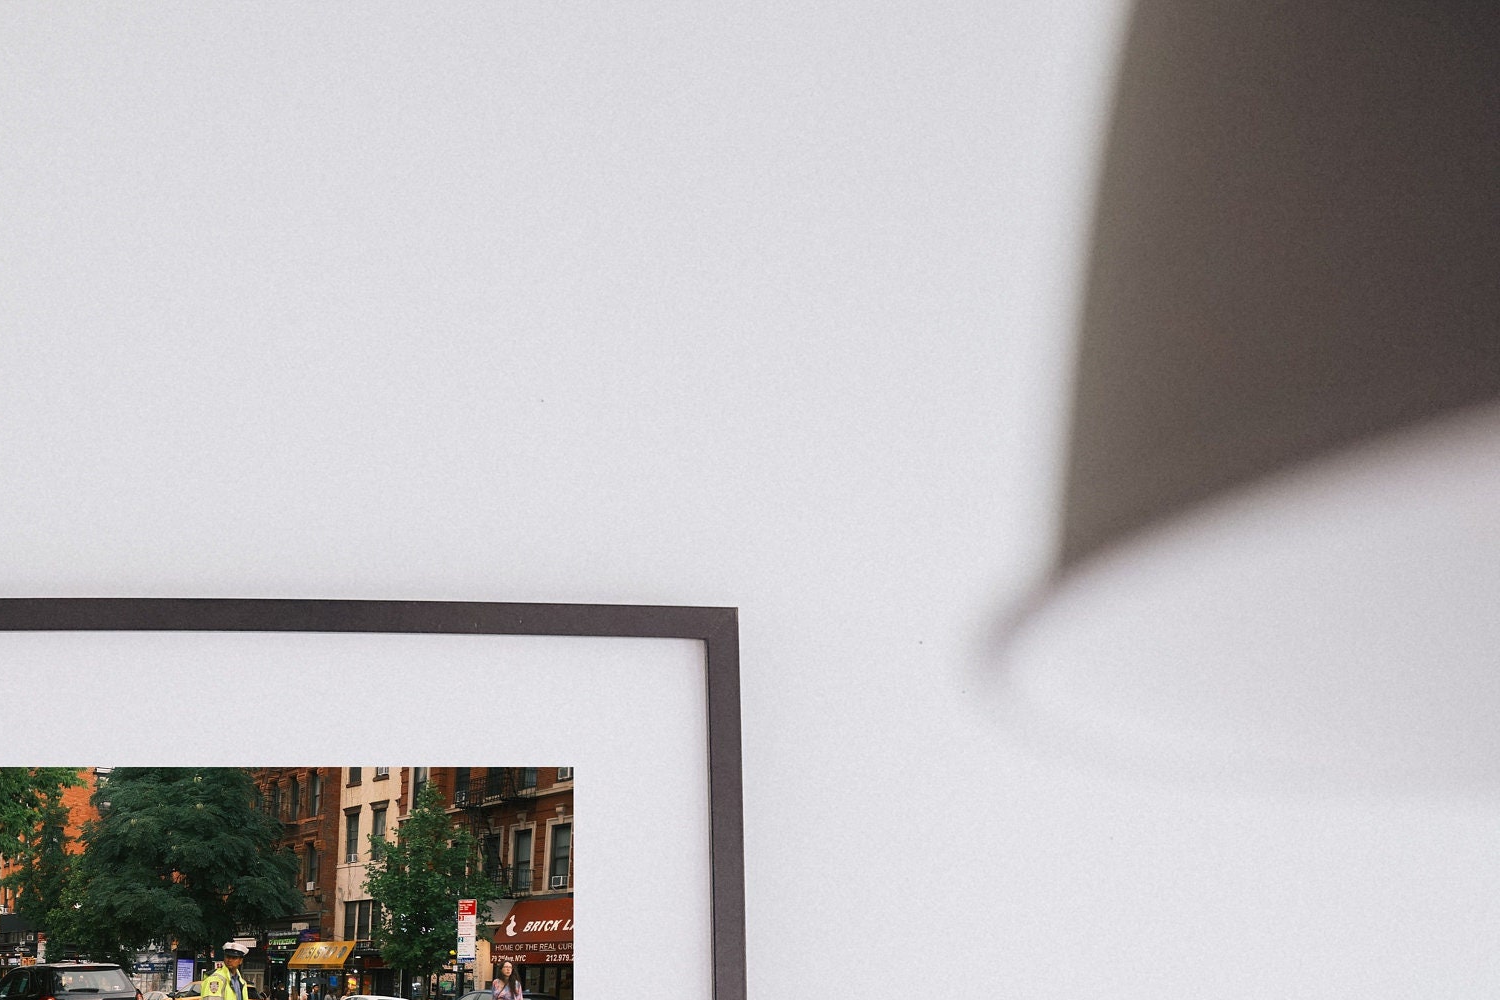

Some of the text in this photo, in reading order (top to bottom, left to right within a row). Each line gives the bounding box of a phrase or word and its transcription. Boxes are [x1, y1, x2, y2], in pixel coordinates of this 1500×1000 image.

[523, 919, 563, 932] BRICK
[525, 943, 538, 951] THE
[539, 943, 556, 951] REAL
